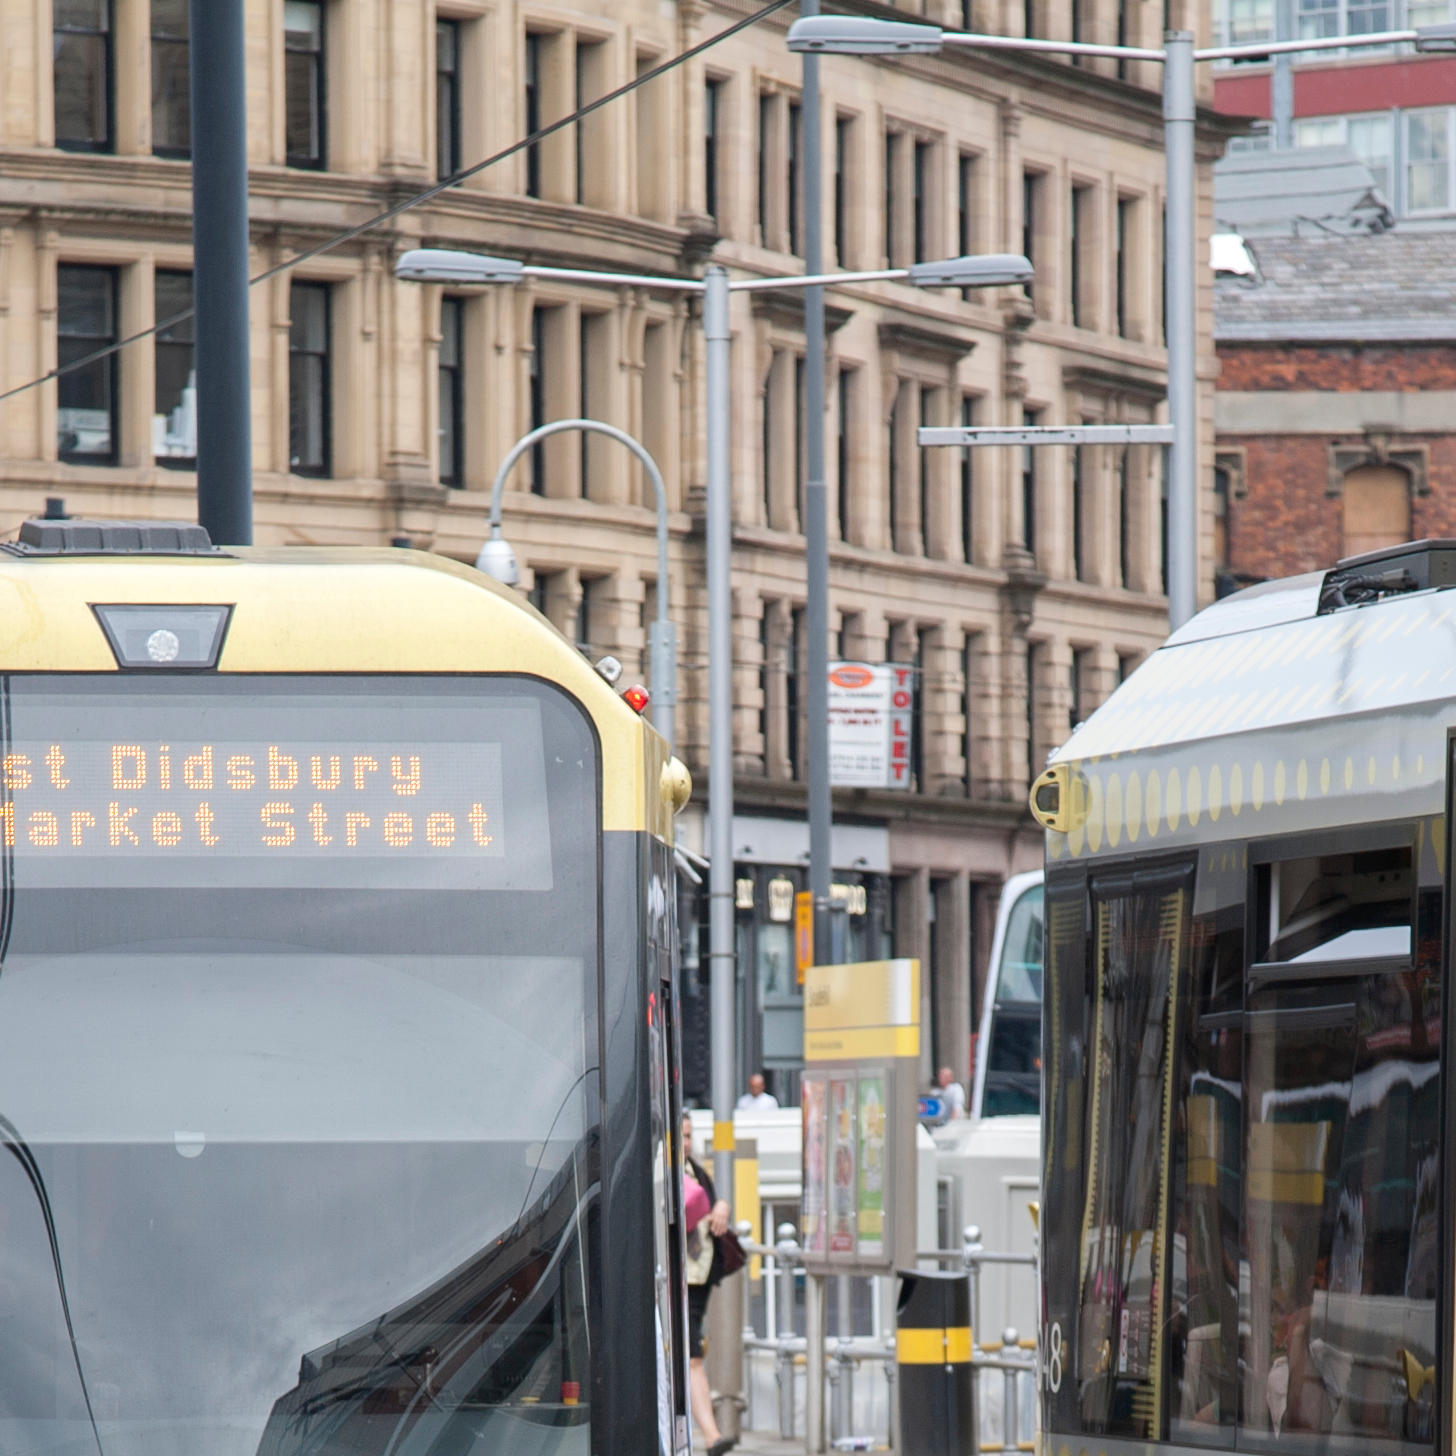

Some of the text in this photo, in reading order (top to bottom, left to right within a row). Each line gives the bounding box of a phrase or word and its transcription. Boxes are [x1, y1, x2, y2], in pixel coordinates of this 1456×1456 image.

[891, 669, 912, 780] TO LET
[111, 745, 421, 796] Didsbury
[260, 802, 493, 848] Street
